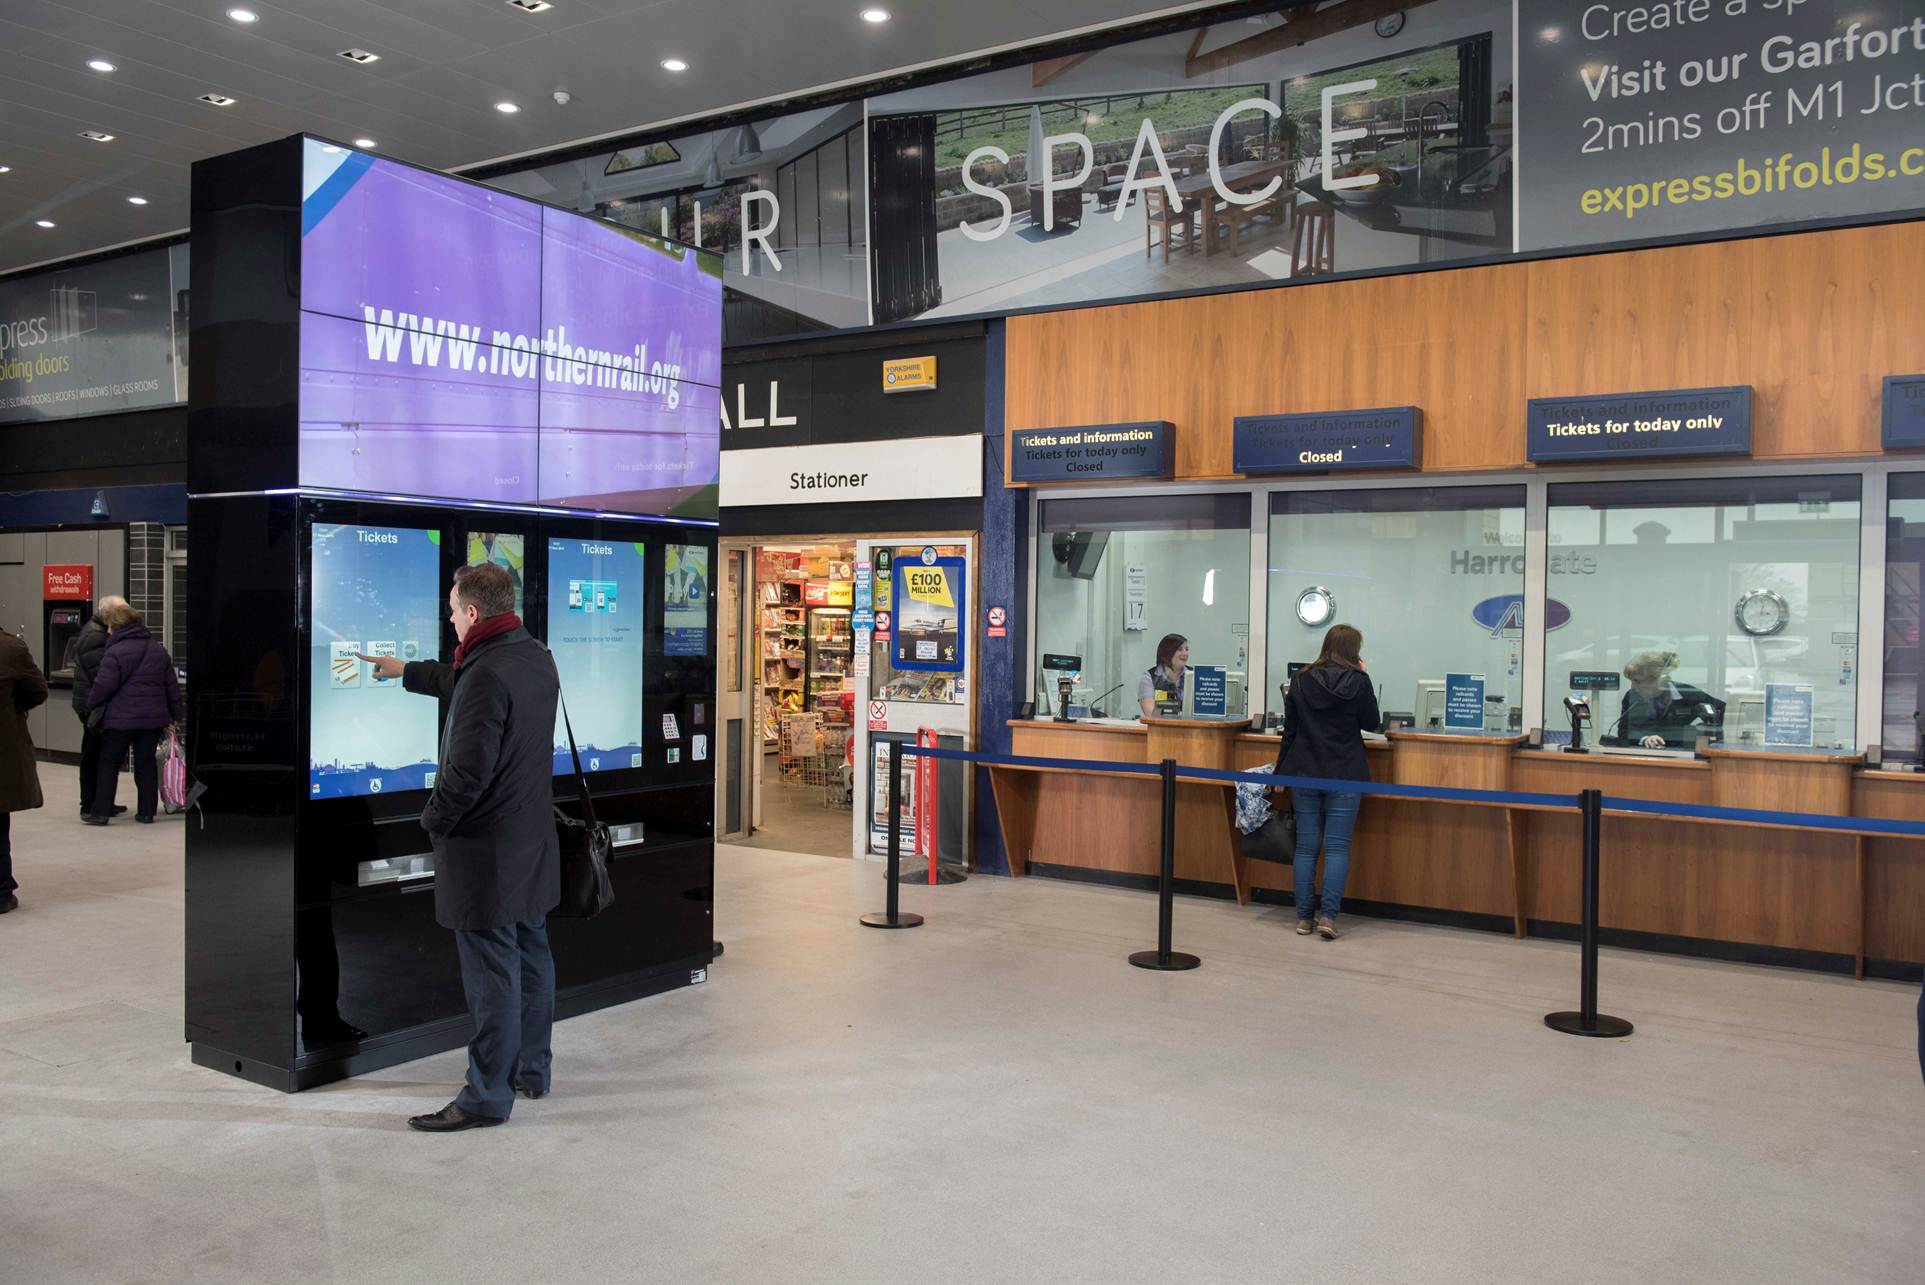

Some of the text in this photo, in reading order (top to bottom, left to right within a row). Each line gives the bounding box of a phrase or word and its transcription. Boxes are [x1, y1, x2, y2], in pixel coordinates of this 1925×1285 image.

[1581, 0, 1710, 40] Create
[1580, 17, 1925, 102] Visit our Garfort
[1581, 73, 1925, 153] 2mins off M1 Jct
[959, 79, 1381, 243] SPACE
[1580, 143, 1925, 219] expressbifolds.c
[0, 316, 47, 360] press
[36, 352, 69, 376] doors
[364, 305, 681, 410] www.northernrail.org
[886, 364, 921, 374] YORKSHIRE
[896, 373, 922, 382] ALARMS
[32, 392, 52, 406] DOORS
[55, 390, 76, 402] ROOFS
[80, 385, 110, 399] WINDOWS
[112, 382, 134, 395] GLASS
[134, 379, 159, 392] ROOMS
[1542, 397, 1731, 420] Tickets and information
[1247, 417, 1400, 435] Tickets and information
[1546, 414, 1723, 437] Tickets for today only
[1020, 429, 1153, 447] Tickets and information
[1606, 436, 1660, 450] Closed
[1026, 444, 1146, 460] Tickets for today only
[1299, 450, 1342, 464] Closed
[1066, 461, 1103, 472] Closed
[790, 472, 869, 490] Stationer
[356, 530, 398, 544] Tickets
[582, 543, 613, 556] Tickets
[1450, 550, 1598, 575] Harroate
[48, 572, 82, 584] Free Cash
[912, 574, 942, 586] £100
[1130, 603, 1144, 620] 17
